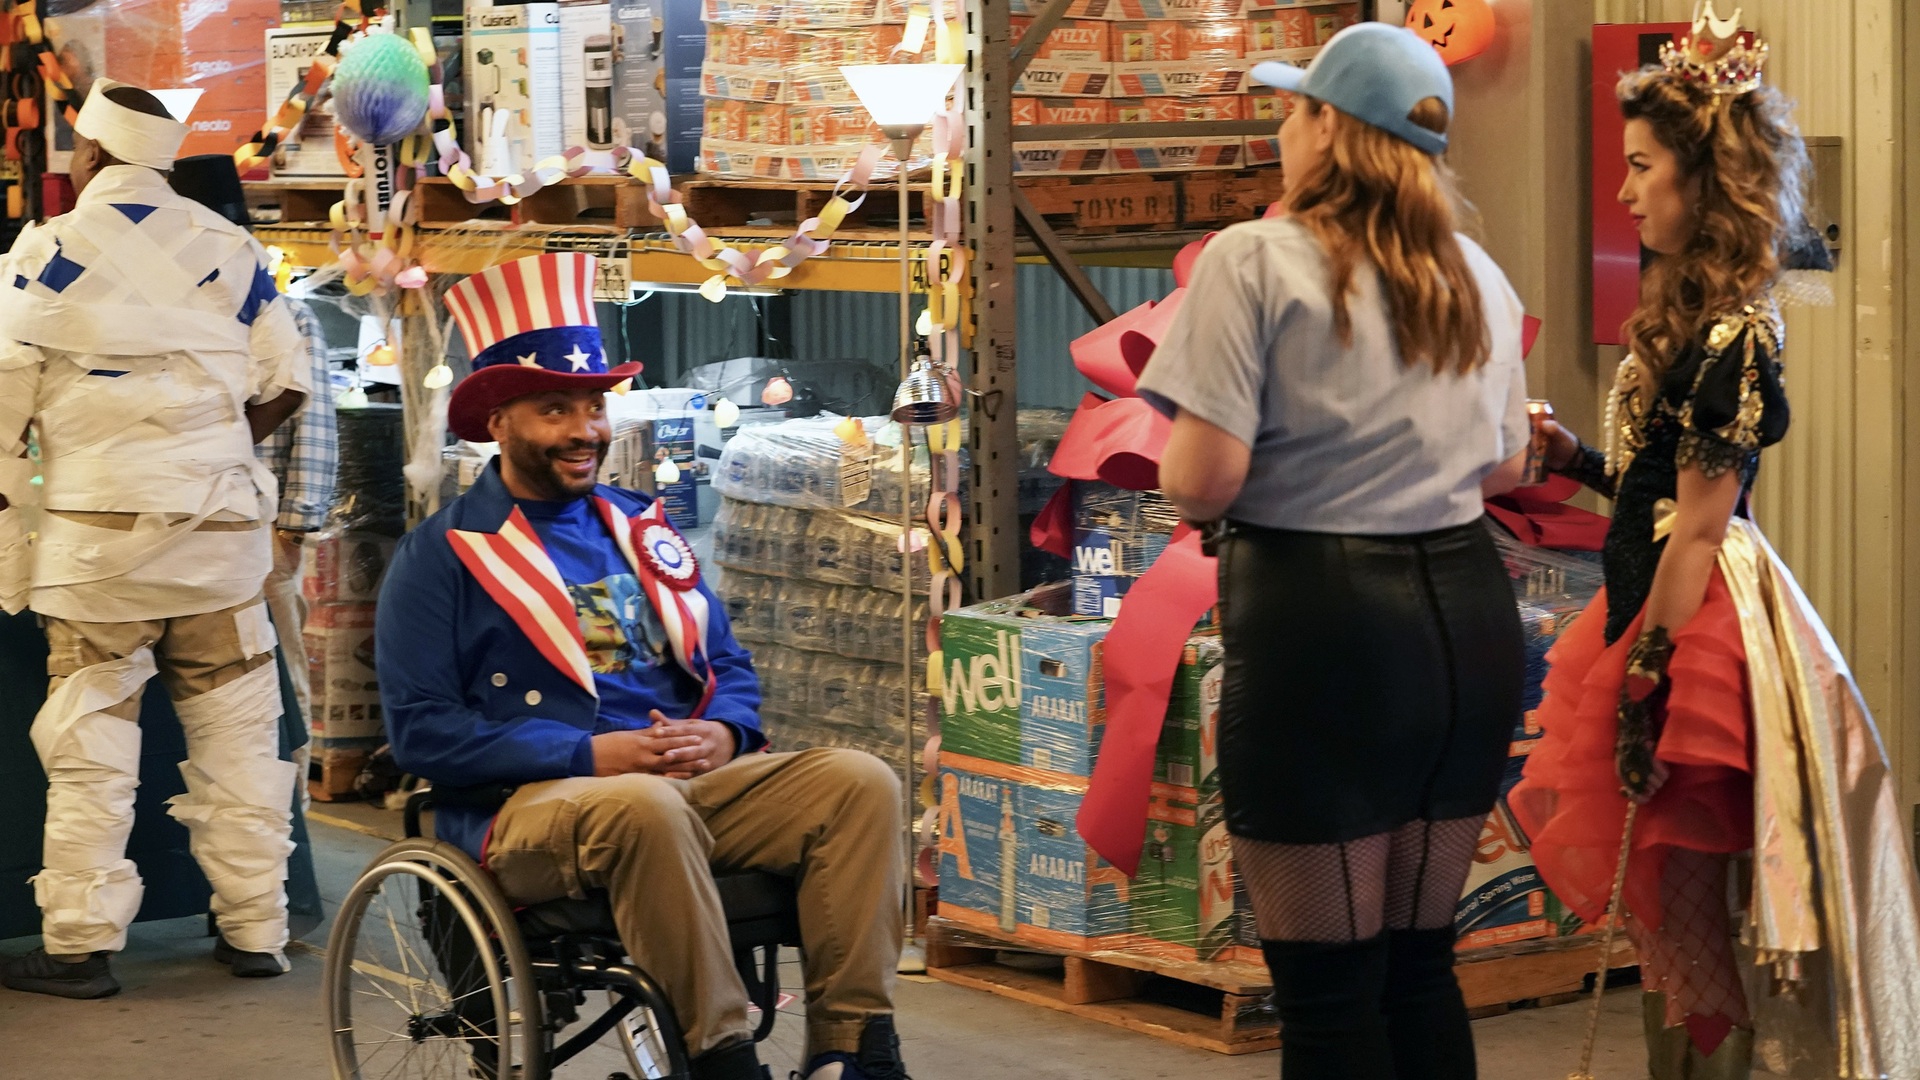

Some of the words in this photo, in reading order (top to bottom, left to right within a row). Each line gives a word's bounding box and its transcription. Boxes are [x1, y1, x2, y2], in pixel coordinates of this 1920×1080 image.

[480, 14, 518, 27] Cuisinart
[1051, 29, 1101, 43] VIZZY
[191, 61, 232, 73] neato
[1025, 71, 1064, 83] VIZZY
[1048, 108, 1100, 122] VIZZY
[191, 120, 231, 131] neato
[1019, 149, 1060, 161] VIZZY
[1159, 145, 1198, 157] VIZZY
[1073, 196, 1134, 219] TOYS
[657, 424, 690, 439] Oster
[1075, 539, 1123, 576] well
[942, 630, 1021, 717] well
[1031, 694, 1085, 724] ARARAT
[1029, 853, 1085, 885] ARARAT
[1454, 896, 1481, 923] atural
[1479, 882, 1513, 904] Spring
[1510, 873, 1536, 886] Water
